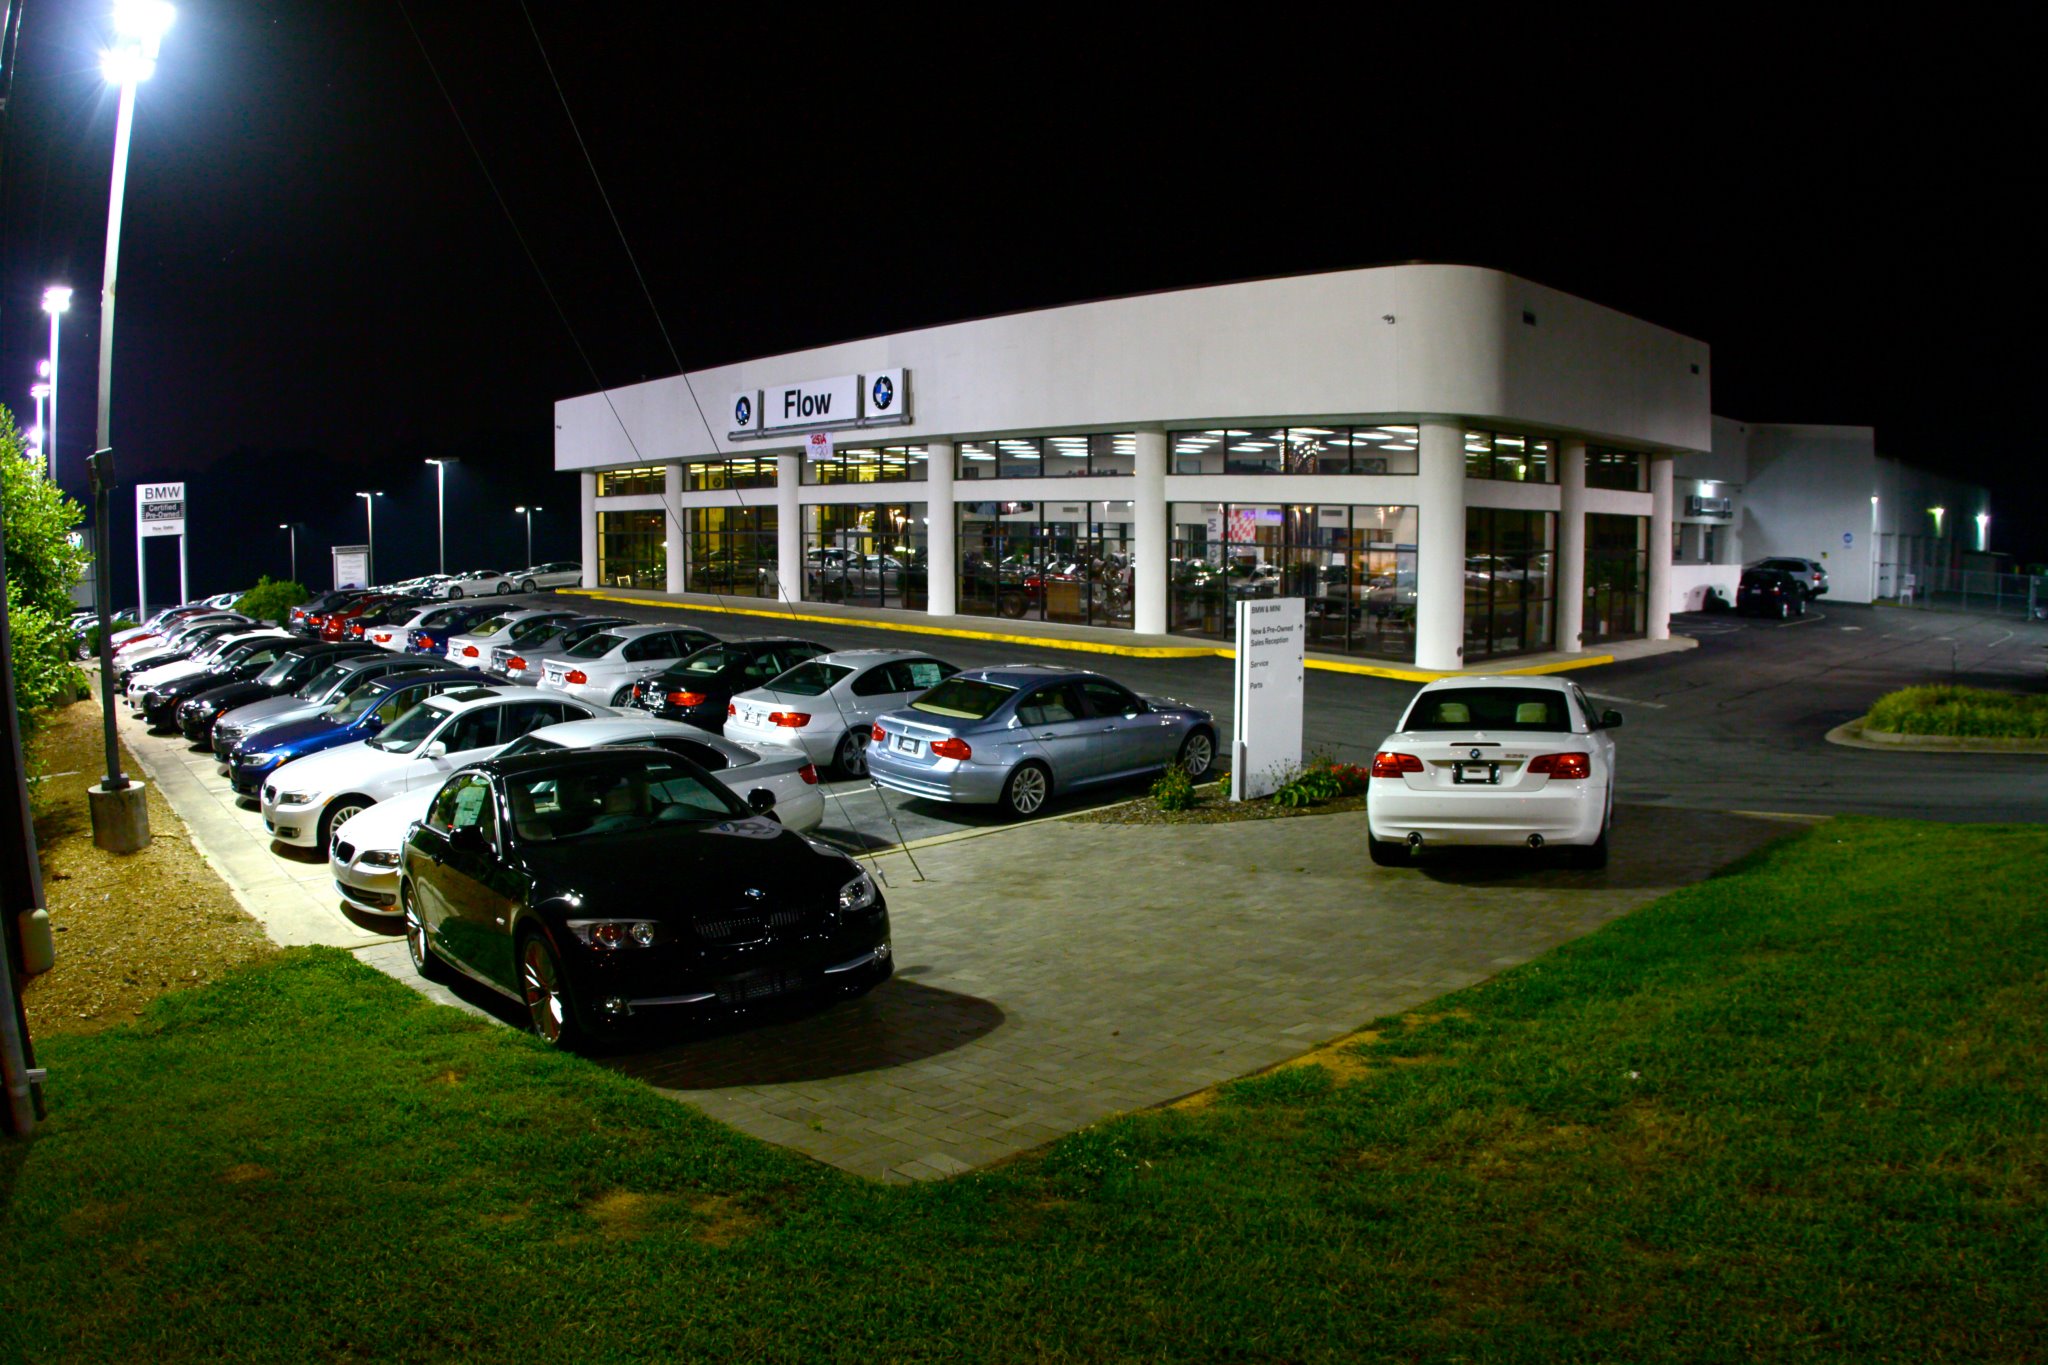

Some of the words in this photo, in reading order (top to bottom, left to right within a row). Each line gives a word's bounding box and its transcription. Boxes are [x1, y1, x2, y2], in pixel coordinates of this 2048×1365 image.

[784, 389, 832, 419] Flow
[145, 486, 181, 500] BMW
[149, 504, 177, 512] Certified
[145, 511, 180, 519] Pre-Owned
[1251, 605, 1265, 614] BMW
[1269, 604, 1281, 612] MINI
[1251, 627, 1262, 635] New
[1267, 624, 1294, 633] Pre-Owned
[1250, 638, 1264, 647] Sales
[1265, 636, 1289, 645] Reception
[1250, 660, 1269, 669] Service
[1250, 682, 1263, 690] Parts
